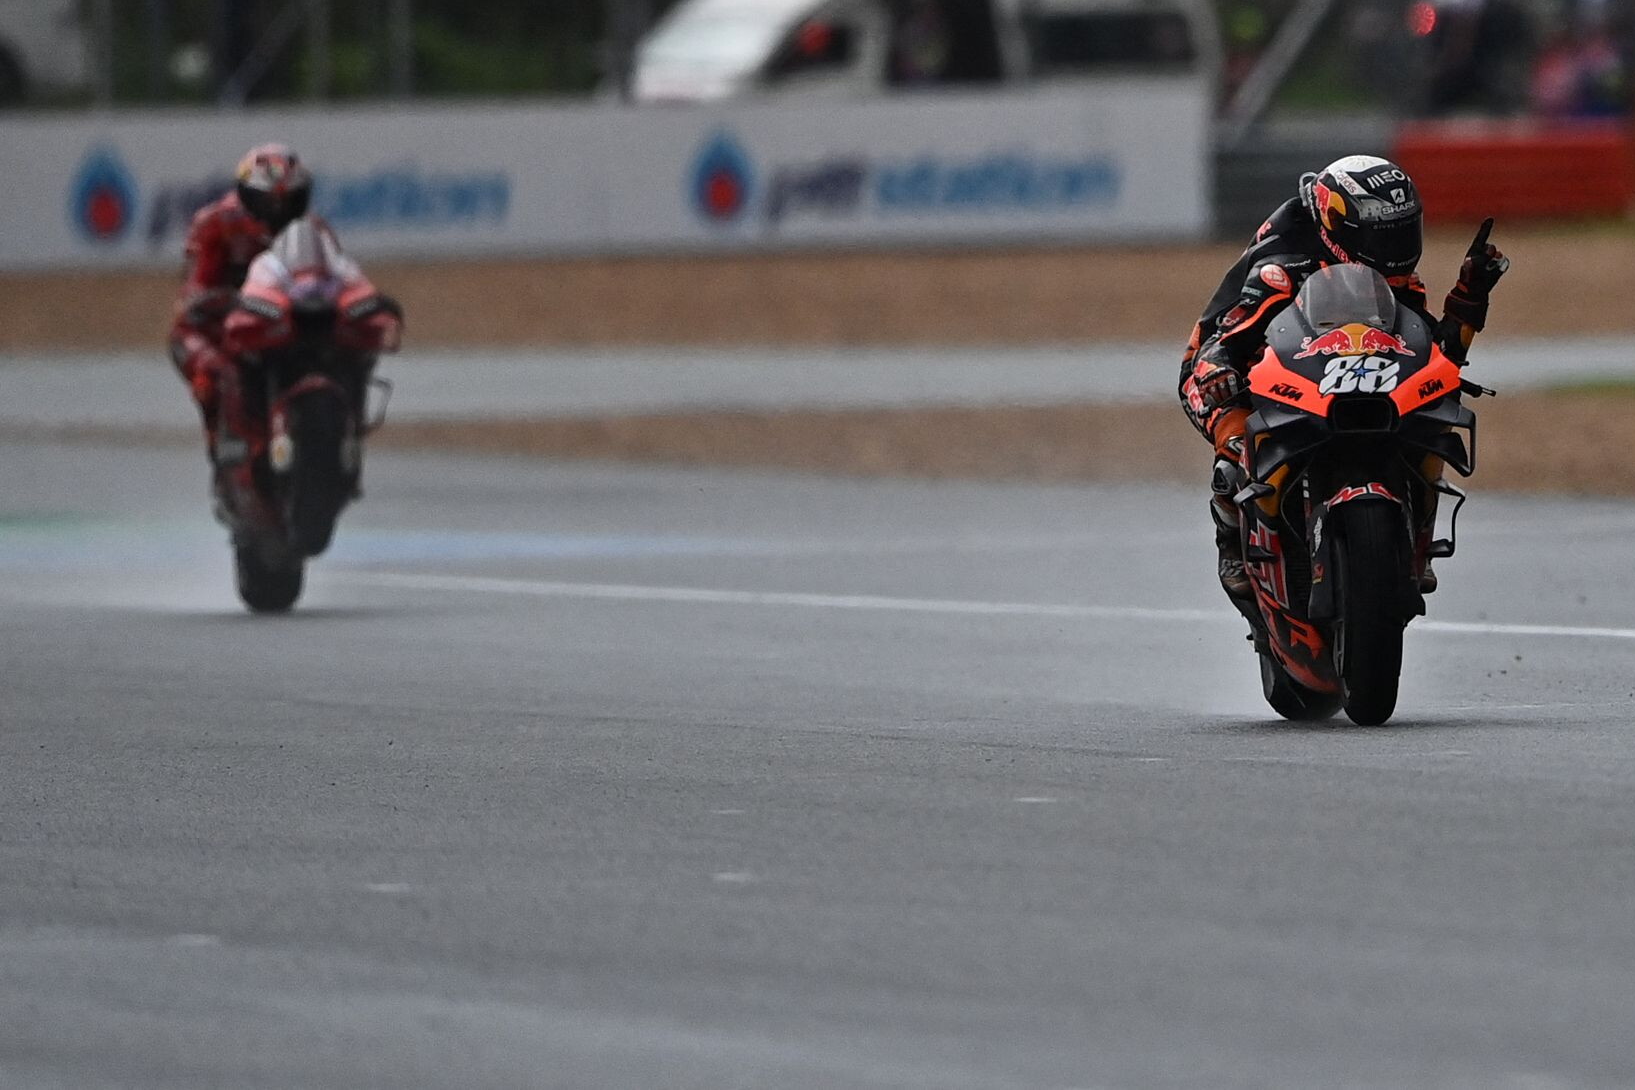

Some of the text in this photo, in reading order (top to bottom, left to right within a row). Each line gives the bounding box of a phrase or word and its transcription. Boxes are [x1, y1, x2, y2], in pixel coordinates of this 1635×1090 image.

[1381, 200, 1416, 215] SHARK
[1318, 354, 1400, 398] 88
[1269, 382, 1304, 402] KTM
[1418, 379, 1444, 399] KTM
